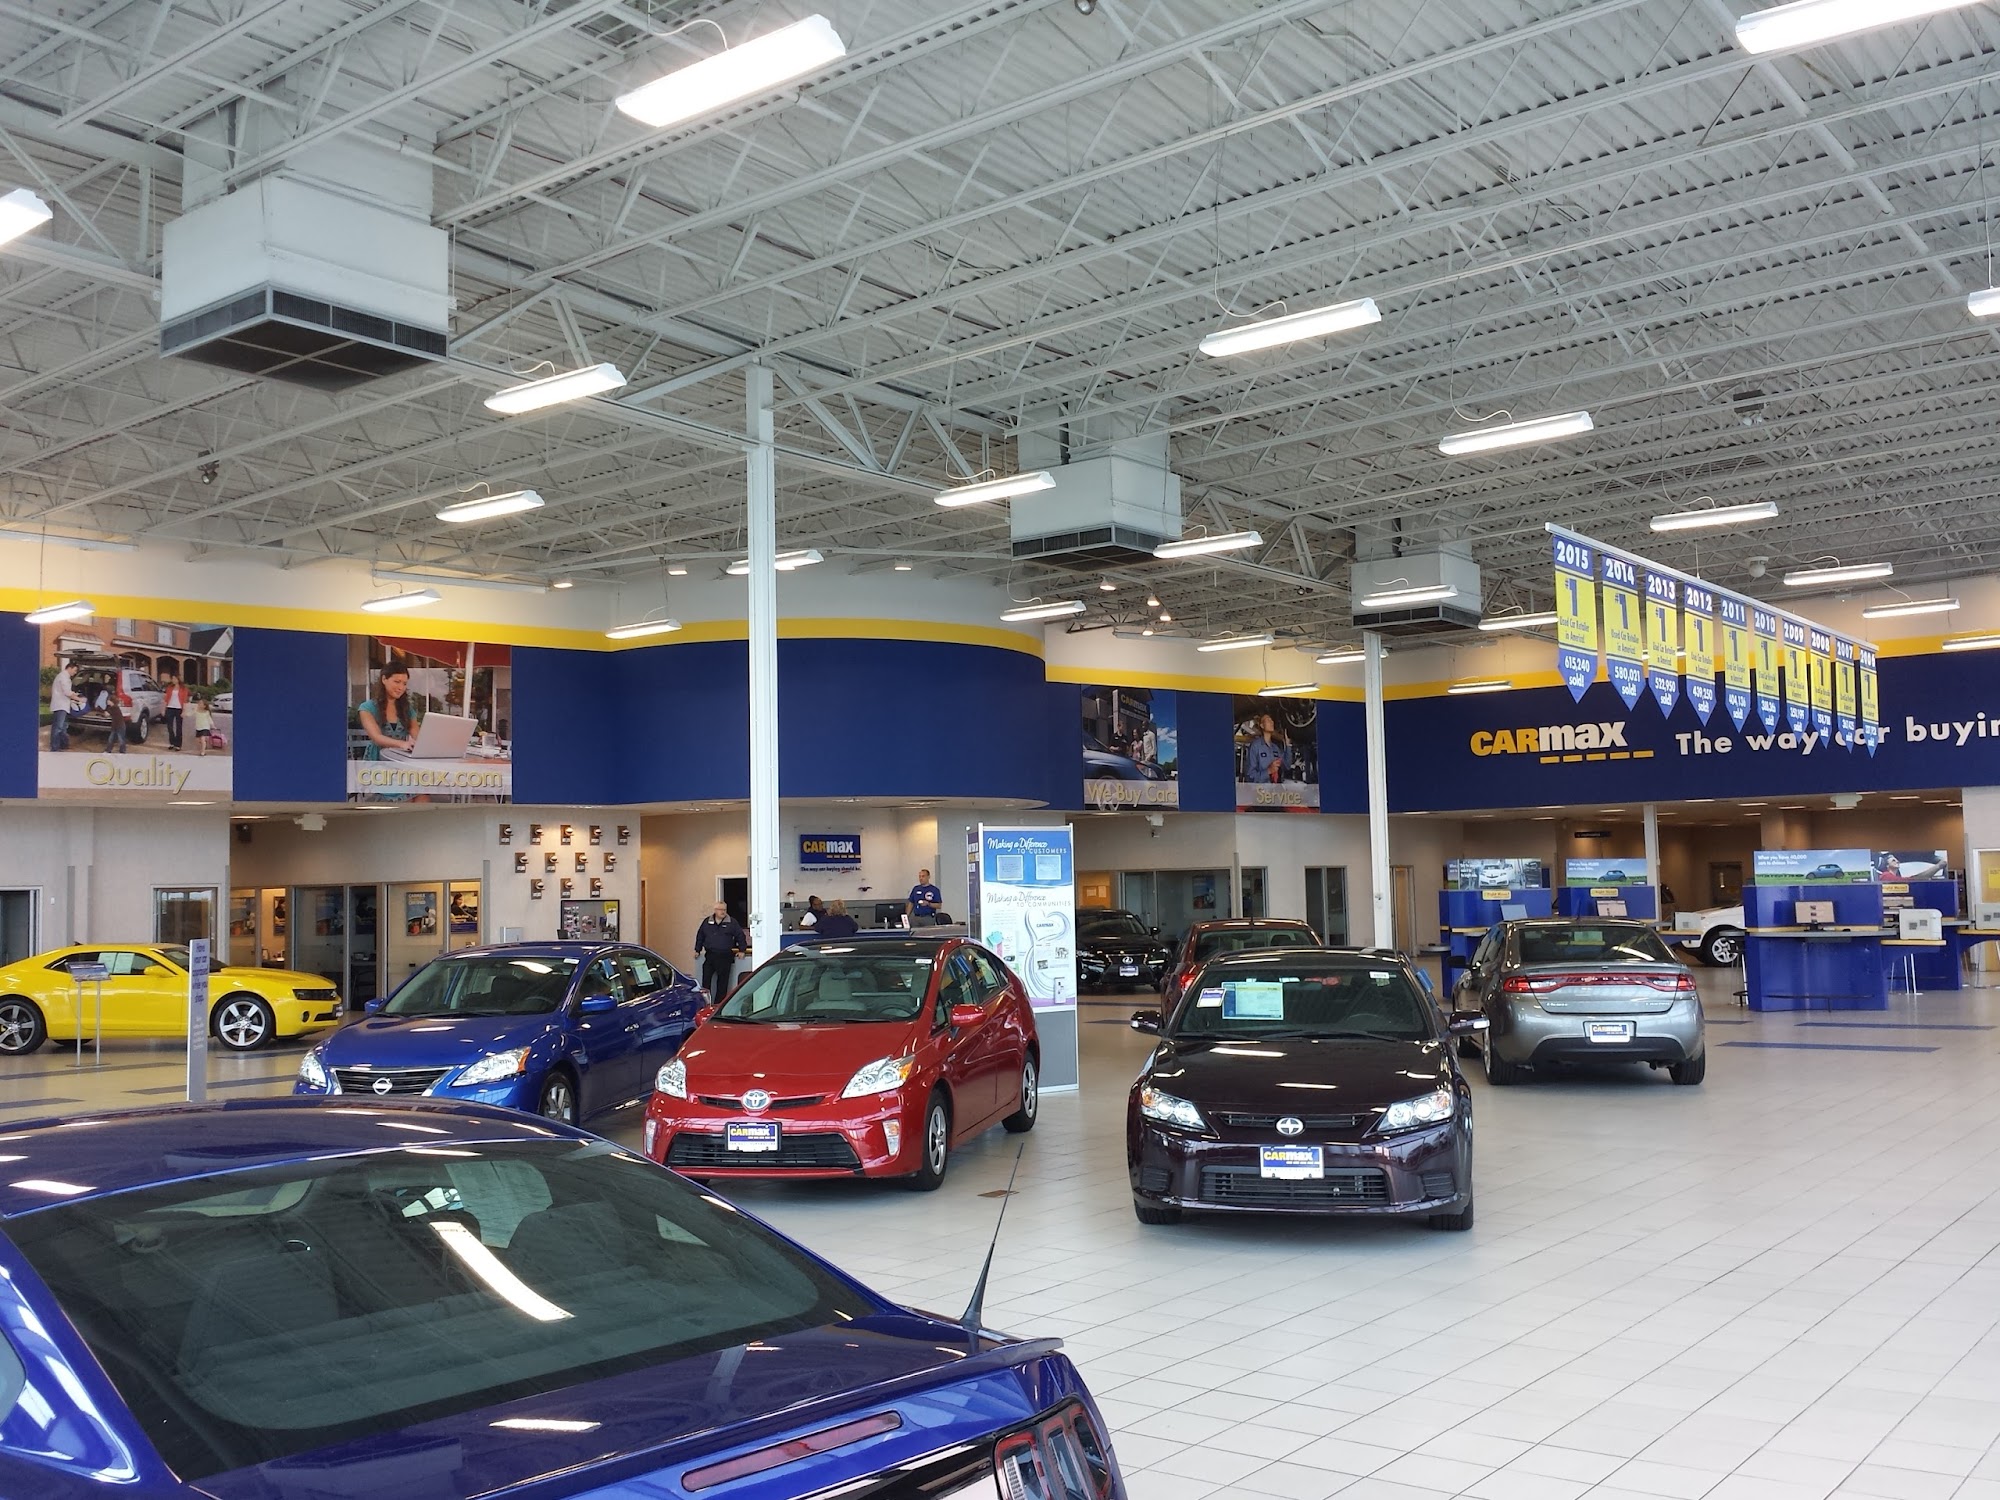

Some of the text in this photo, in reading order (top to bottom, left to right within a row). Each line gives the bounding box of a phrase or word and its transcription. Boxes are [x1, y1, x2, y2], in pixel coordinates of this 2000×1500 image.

[1556, 540, 1589, 570] 2015
[1606, 558, 1635, 586] 2014
[1565, 578, 1578, 617] #1
[1648, 575, 1676, 600] 2013
[1686, 587, 1713, 612] 2012
[1615, 593, 1629, 630] #1
[1722, 600, 1745, 622] 2011
[1754, 611, 1776, 633] 2010
[1655, 608, 1666, 642] #1
[1784, 622, 1804, 643] 2009
[1811, 632, 1830, 652] 2008
[1837, 641, 1853, 660] 2007
[1565, 656, 1590, 673] 615,240
[1614, 666, 1641, 682] 580,021
[1569, 672, 1585, 688] sold!
[1622, 683, 1637, 697] sold!
[1655, 677, 1676, 693] 522,950
[1660, 692, 1672, 706] sold!
[1698, 700, 1710, 713] sold!
[1470, 721, 1628, 757] CARmax
[1675, 730, 1733, 756] The
[1746, 731, 1819, 756] way
[1835, 726, 1890, 747] car
[86, 756, 191, 795] Quality
[358, 768, 503, 788] carmax.com
[1087, 782, 1178, 808] We Buy Cars
[1256, 783, 1302, 805] Service
[988, 837, 1013, 852] Making
[1019, 837, 1048, 851] Difference
